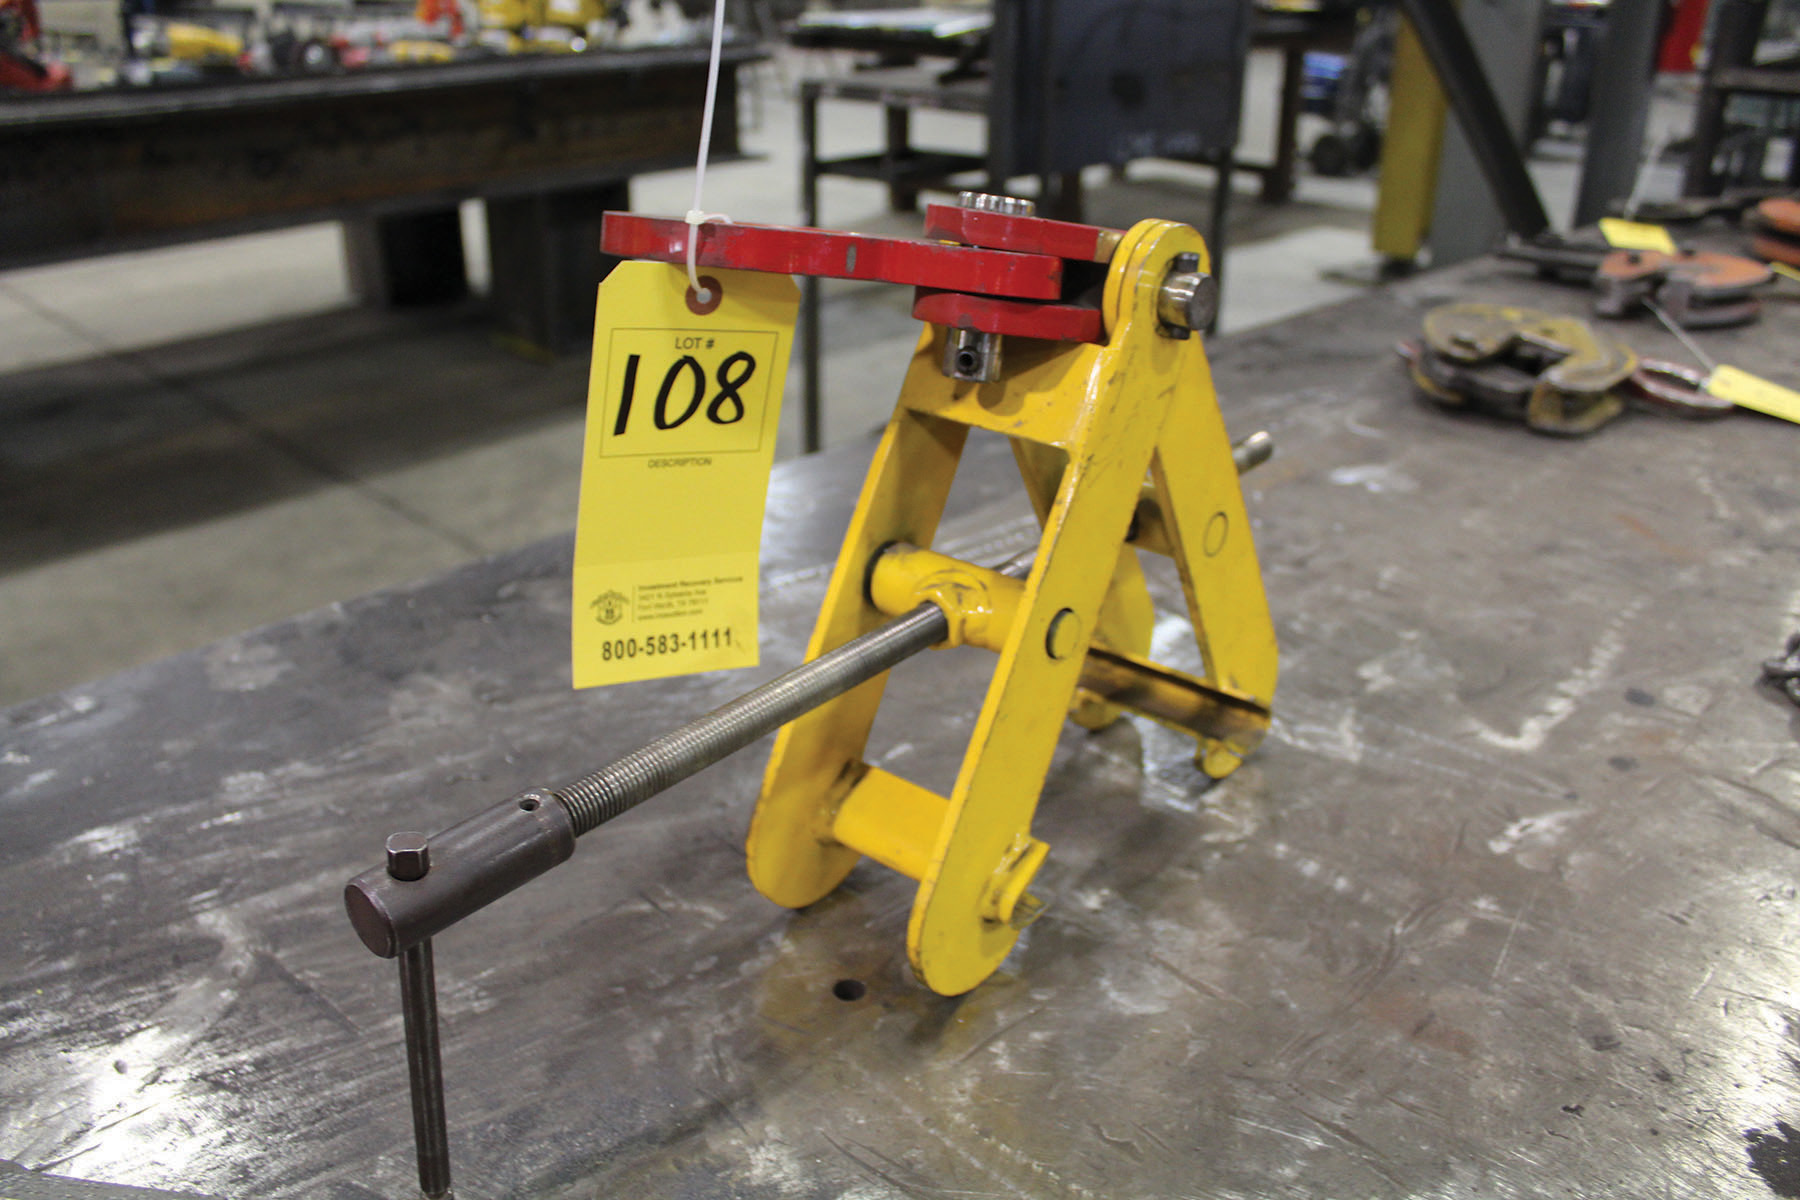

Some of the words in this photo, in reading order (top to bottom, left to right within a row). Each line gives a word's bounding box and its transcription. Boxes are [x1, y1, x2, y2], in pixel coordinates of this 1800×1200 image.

[674, 337, 701, 350] LOT
[705, 337, 715, 350] #
[613, 350, 756, 437] 108
[648, 457, 712, 468] DESCRIPTION
[602, 627, 732, 661] 800-583-1111
